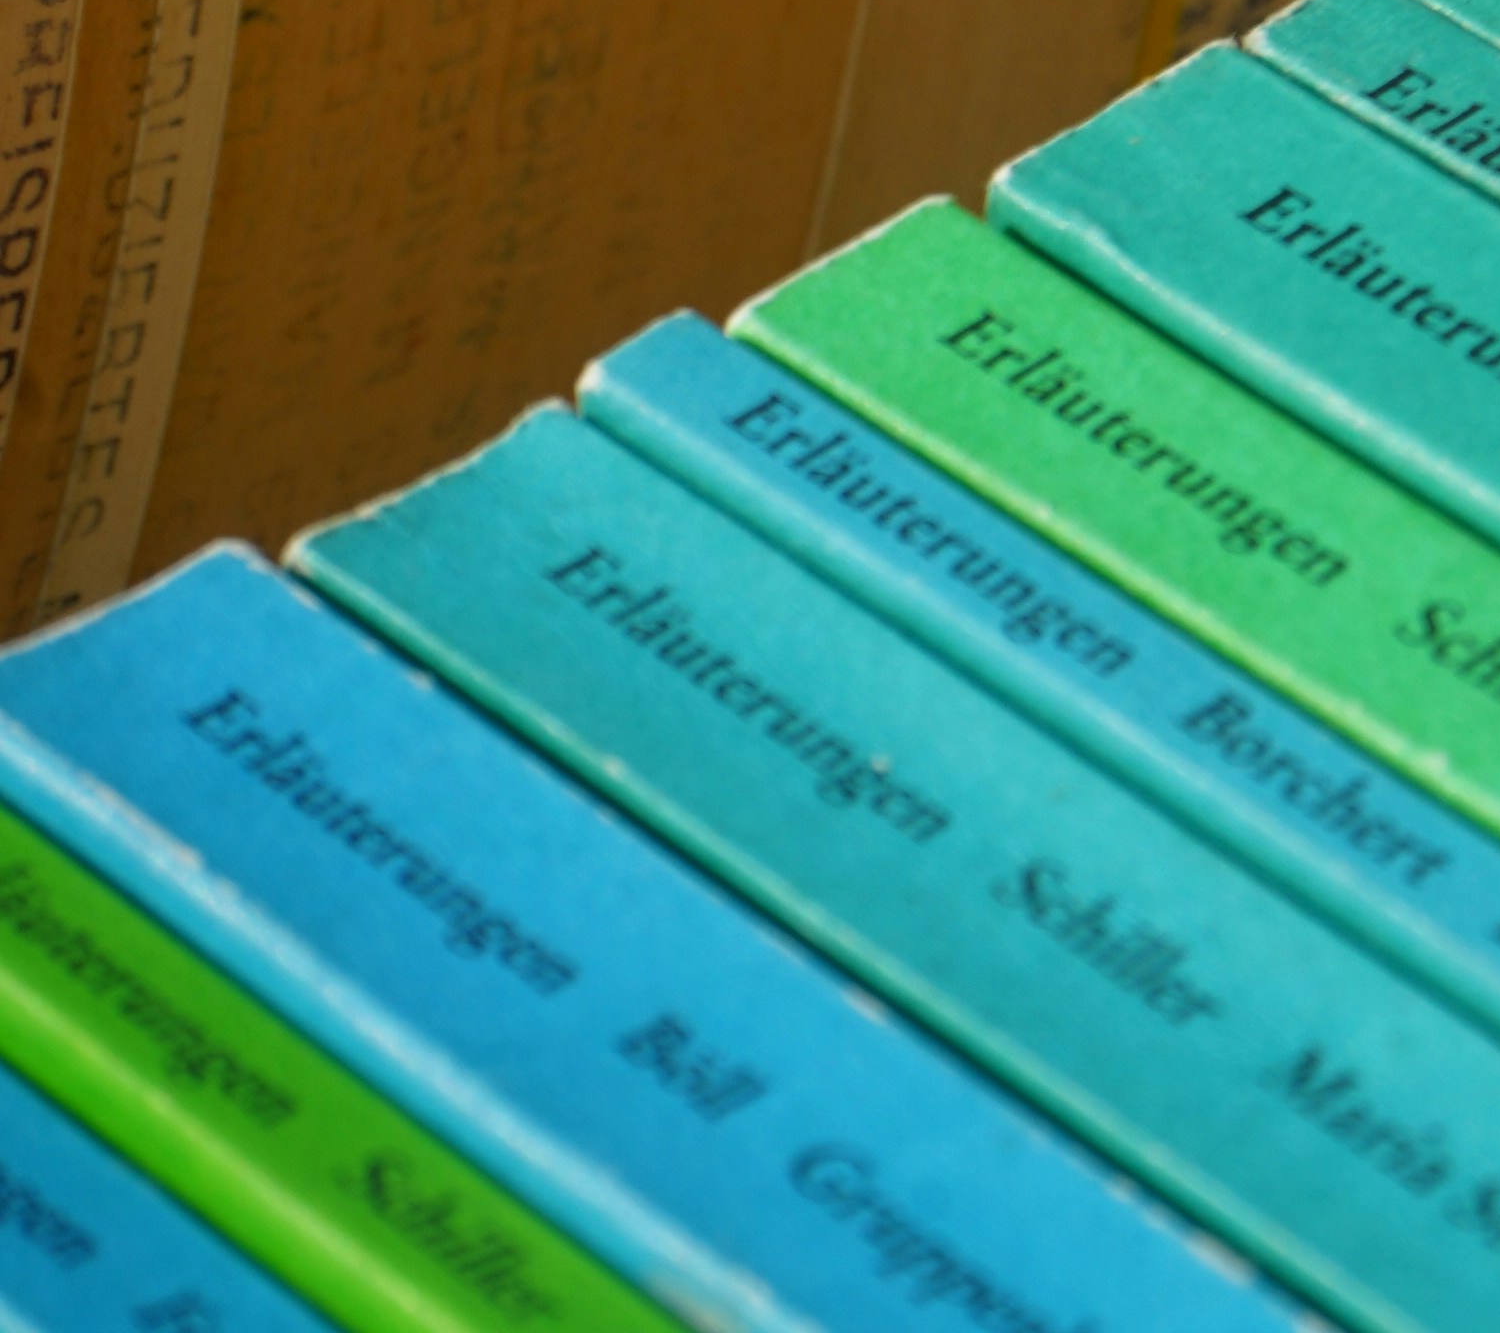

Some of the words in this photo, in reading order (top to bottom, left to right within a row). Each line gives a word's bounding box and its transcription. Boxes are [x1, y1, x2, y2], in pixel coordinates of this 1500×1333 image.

[724, 388, 1139, 681] Erläuterungen
[1178, 689, 1458, 888] Borchert
[932, 308, 1354, 591] Erläuterungen
[180, 687, 580, 1001] Erläuterungen
[540, 541, 958, 847] Erläuterungen
[993, 855, 1228, 1030] Schiller
